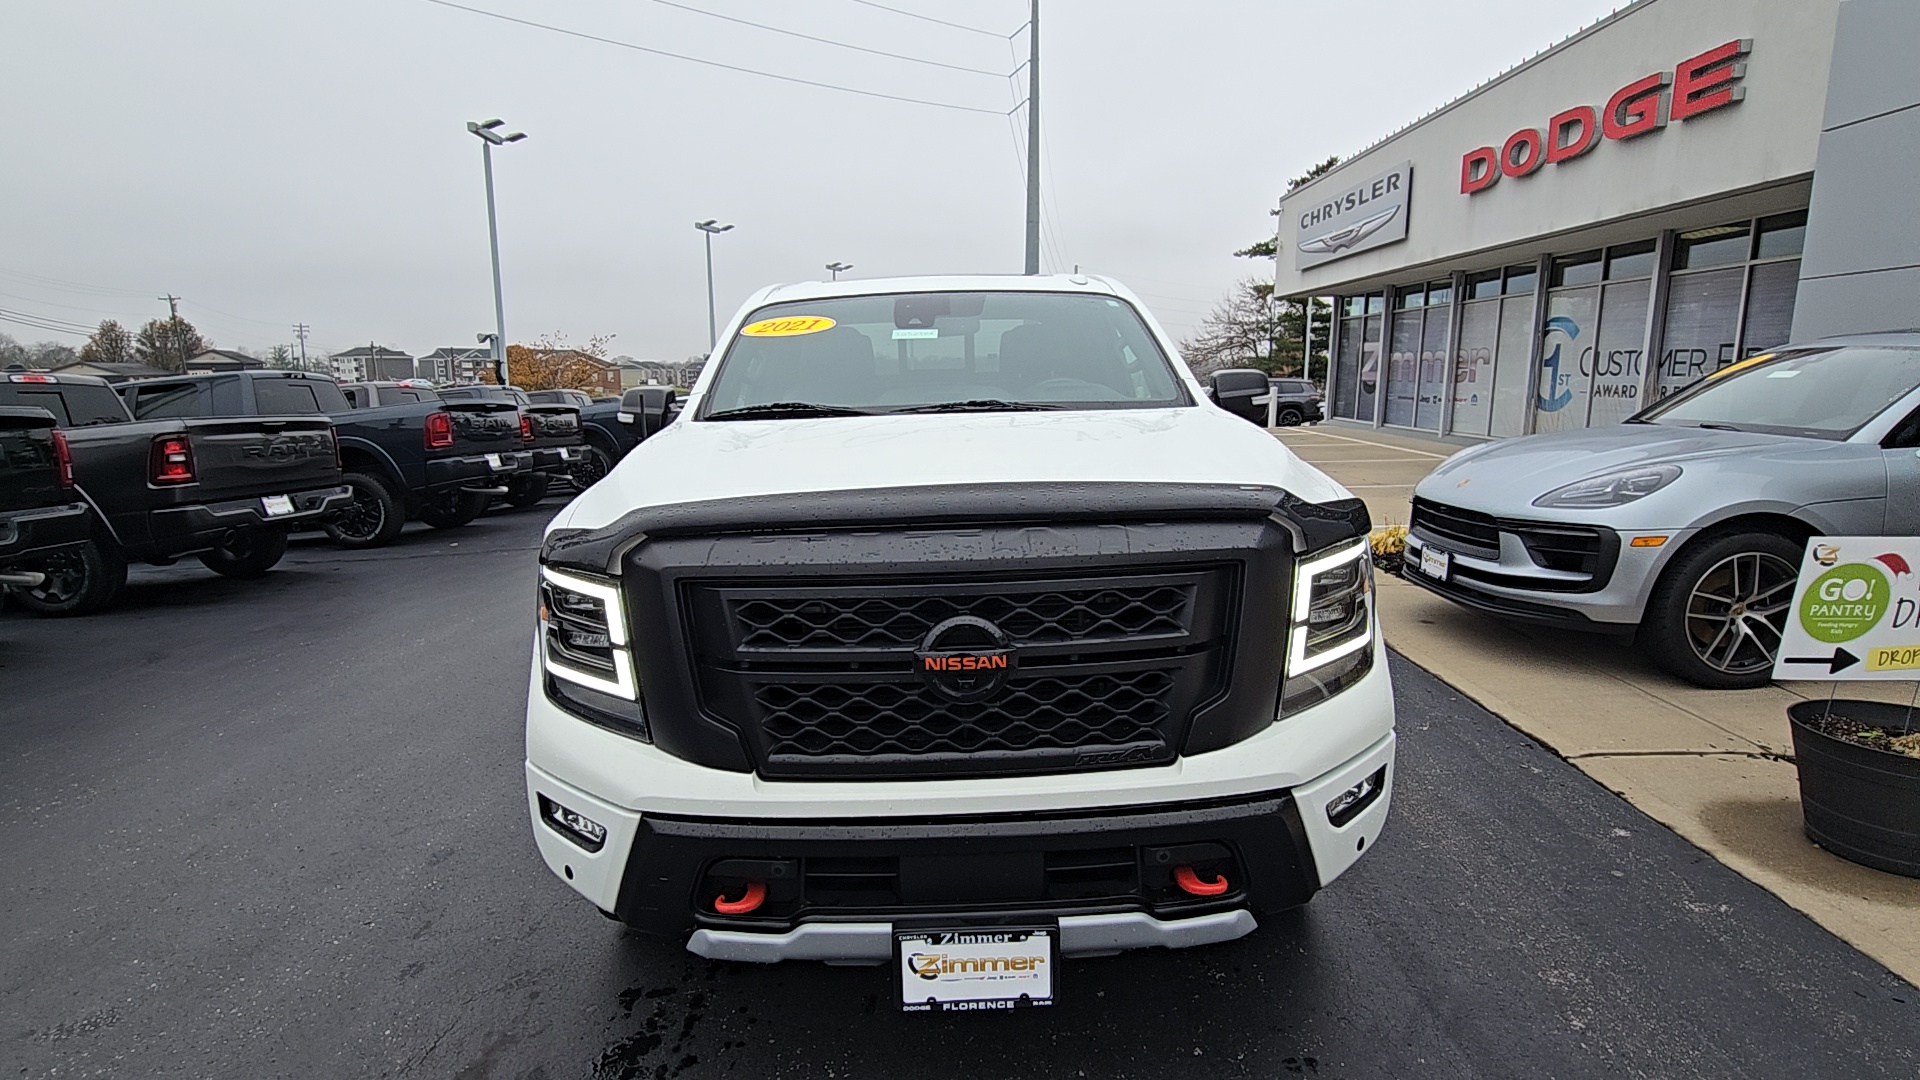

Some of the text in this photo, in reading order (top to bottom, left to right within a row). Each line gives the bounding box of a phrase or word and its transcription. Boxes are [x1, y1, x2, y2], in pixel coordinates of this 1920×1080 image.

[1460, 39, 1750, 195] DODGE
[1300, 172, 1400, 230] CHRYSLER
[755, 320, 820, 333] 2021
[1360, 341, 1490, 383] Zmmer
[1594, 384, 1638, 399] AWARD
[1819, 578, 1876, 601] GO!
[925, 655, 1007, 671] NISSAN
[940, 932, 1013, 946] Zimmer
[916, 953, 1046, 975] Zimmer
[943, 1001, 1015, 1011] FLORENCE
